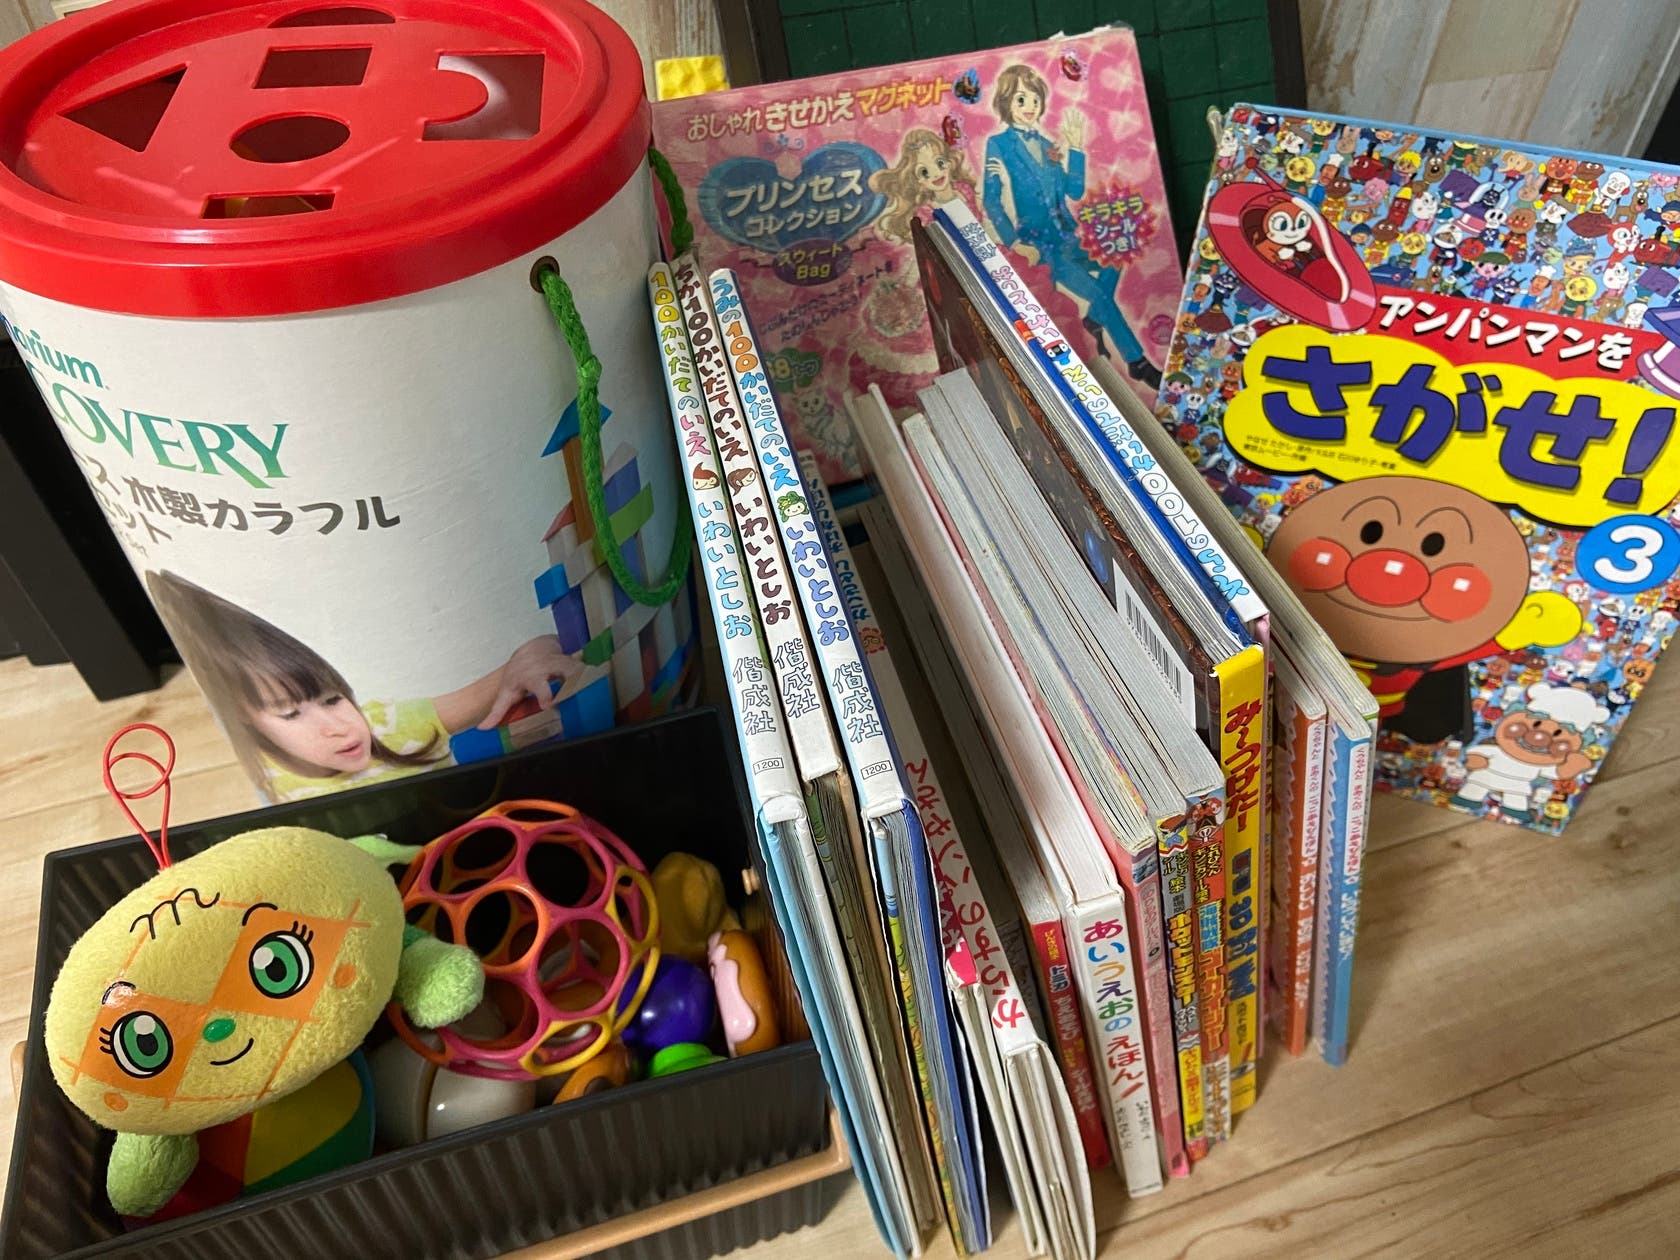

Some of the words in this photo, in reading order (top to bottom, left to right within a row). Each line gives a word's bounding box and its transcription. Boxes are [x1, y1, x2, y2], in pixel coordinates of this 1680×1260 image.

[727, 168, 863, 218] プリンセス
[746, 202, 862, 237] コレクション
[1080, 196, 1144, 224] キラキラ
[1095, 218, 1136, 239] シール
[777, 242, 842, 266] スウィート
[796, 264, 831, 280] Bag
[991, 265, 1060, 345] いわいとしお
[1380, 295, 1633, 369] アンパンマンを
[651, 271, 711, 457] 100かいだてのいえ
[675, 263, 749, 462] ちか100かいだてのいえ
[712, 278, 800, 492] うみの100かいだてのいえ
[1262, 345, 1677, 505] さがせ！
[121, 476, 400, 536] 木製カラフル
[1062, 364, 1250, 601] そらの100かいだてのいえ
[697, 500, 753, 640] いわいとしお
[735, 497, 792, 625] いわいとしお
[786, 521, 850, 646] いわいとしお
[1594, 525, 1664, 584] 3
[733, 656, 777, 736] 偕成社
[774, 638, 821, 718] 偕成社
[832, 661, 883, 744] 偕成社
[756, 759, 780, 770] 1200
[863, 763, 887, 776] 1200
[905, 758, 1025, 1030] からすのパンやさん
[1207, 841, 1223, 876] てれびくん
[1048, 962, 1070, 994] トミカ
[1084, 919, 1134, 1033] あいうえおの
[1169, 909, 1197, 1007] ポケットモンスター
